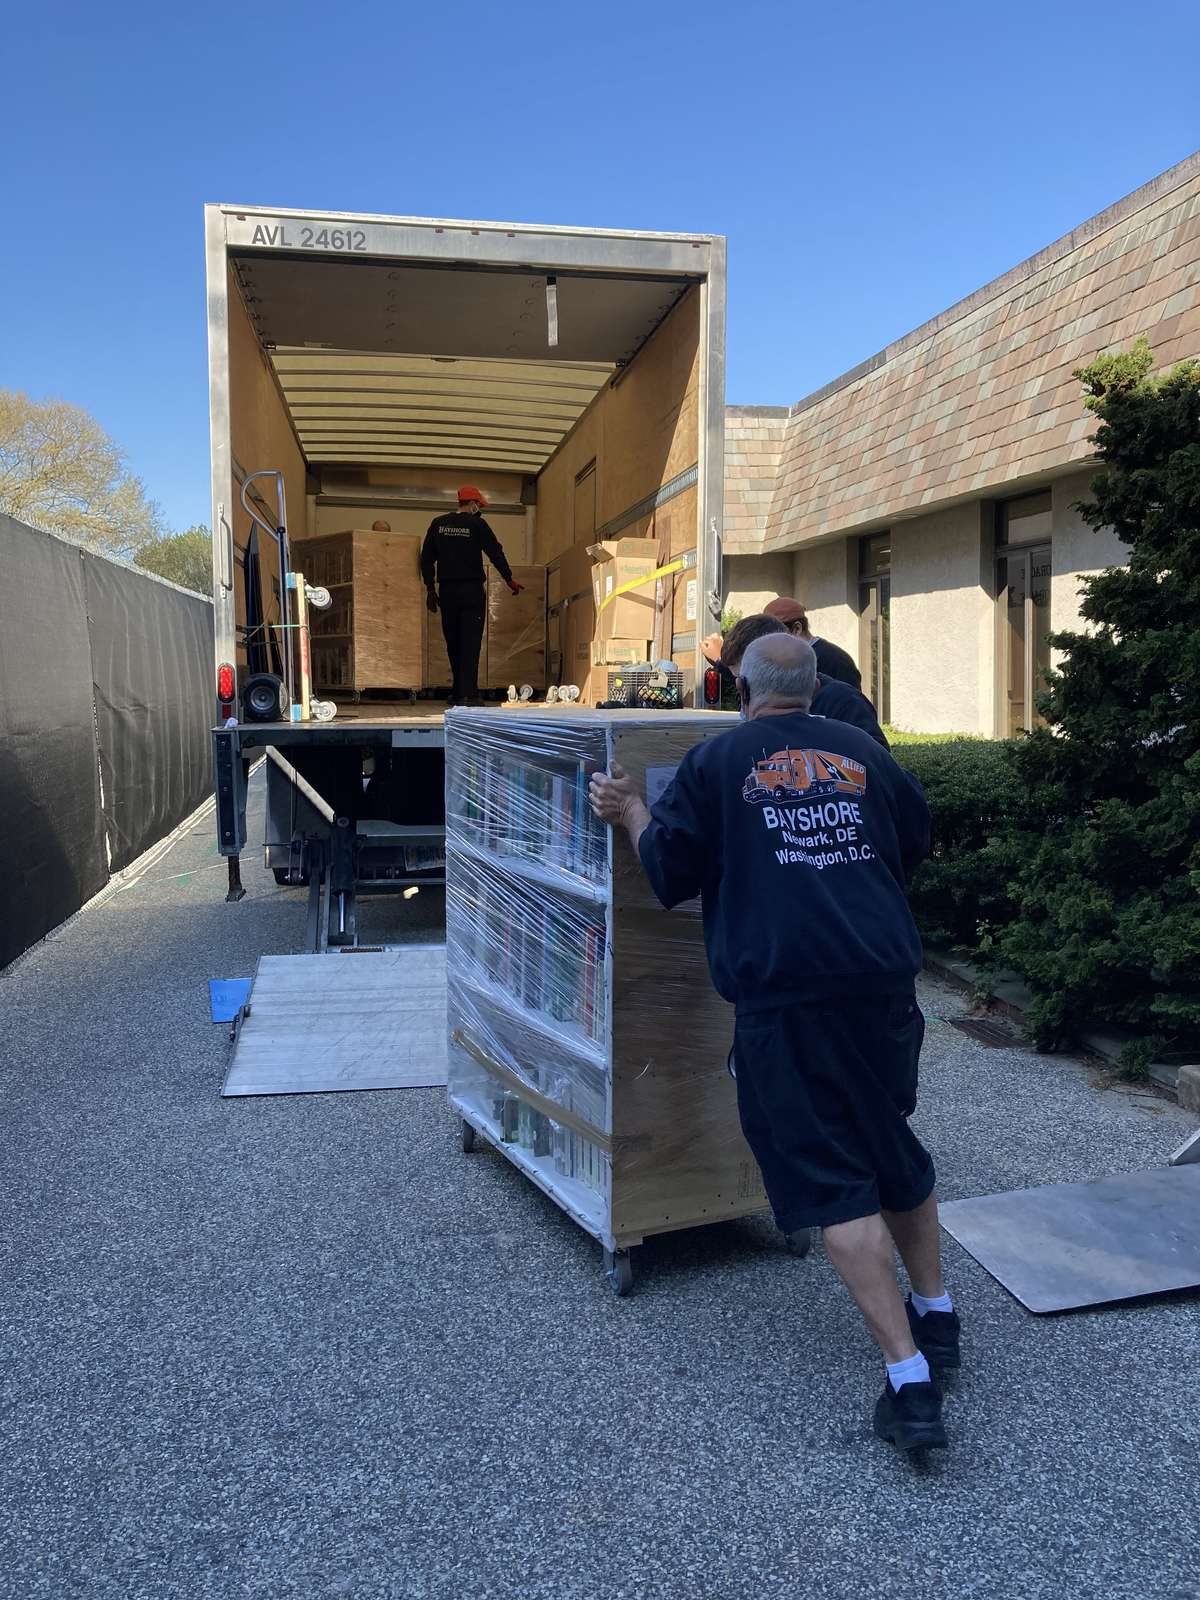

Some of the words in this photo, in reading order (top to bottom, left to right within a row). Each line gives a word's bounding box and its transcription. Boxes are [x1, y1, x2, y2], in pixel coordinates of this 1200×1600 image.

[251, 224, 292, 247] AVL
[301, 227, 367, 251] 24612
[841, 758, 865, 775] ALLIED
[762, 802, 863, 832] BAYSHORE
[782, 830, 833, 848] Newark,
[835, 826, 858, 843] DE
[775, 848, 848, 870] Washington,
[848, 844, 875, 861] D.C.
